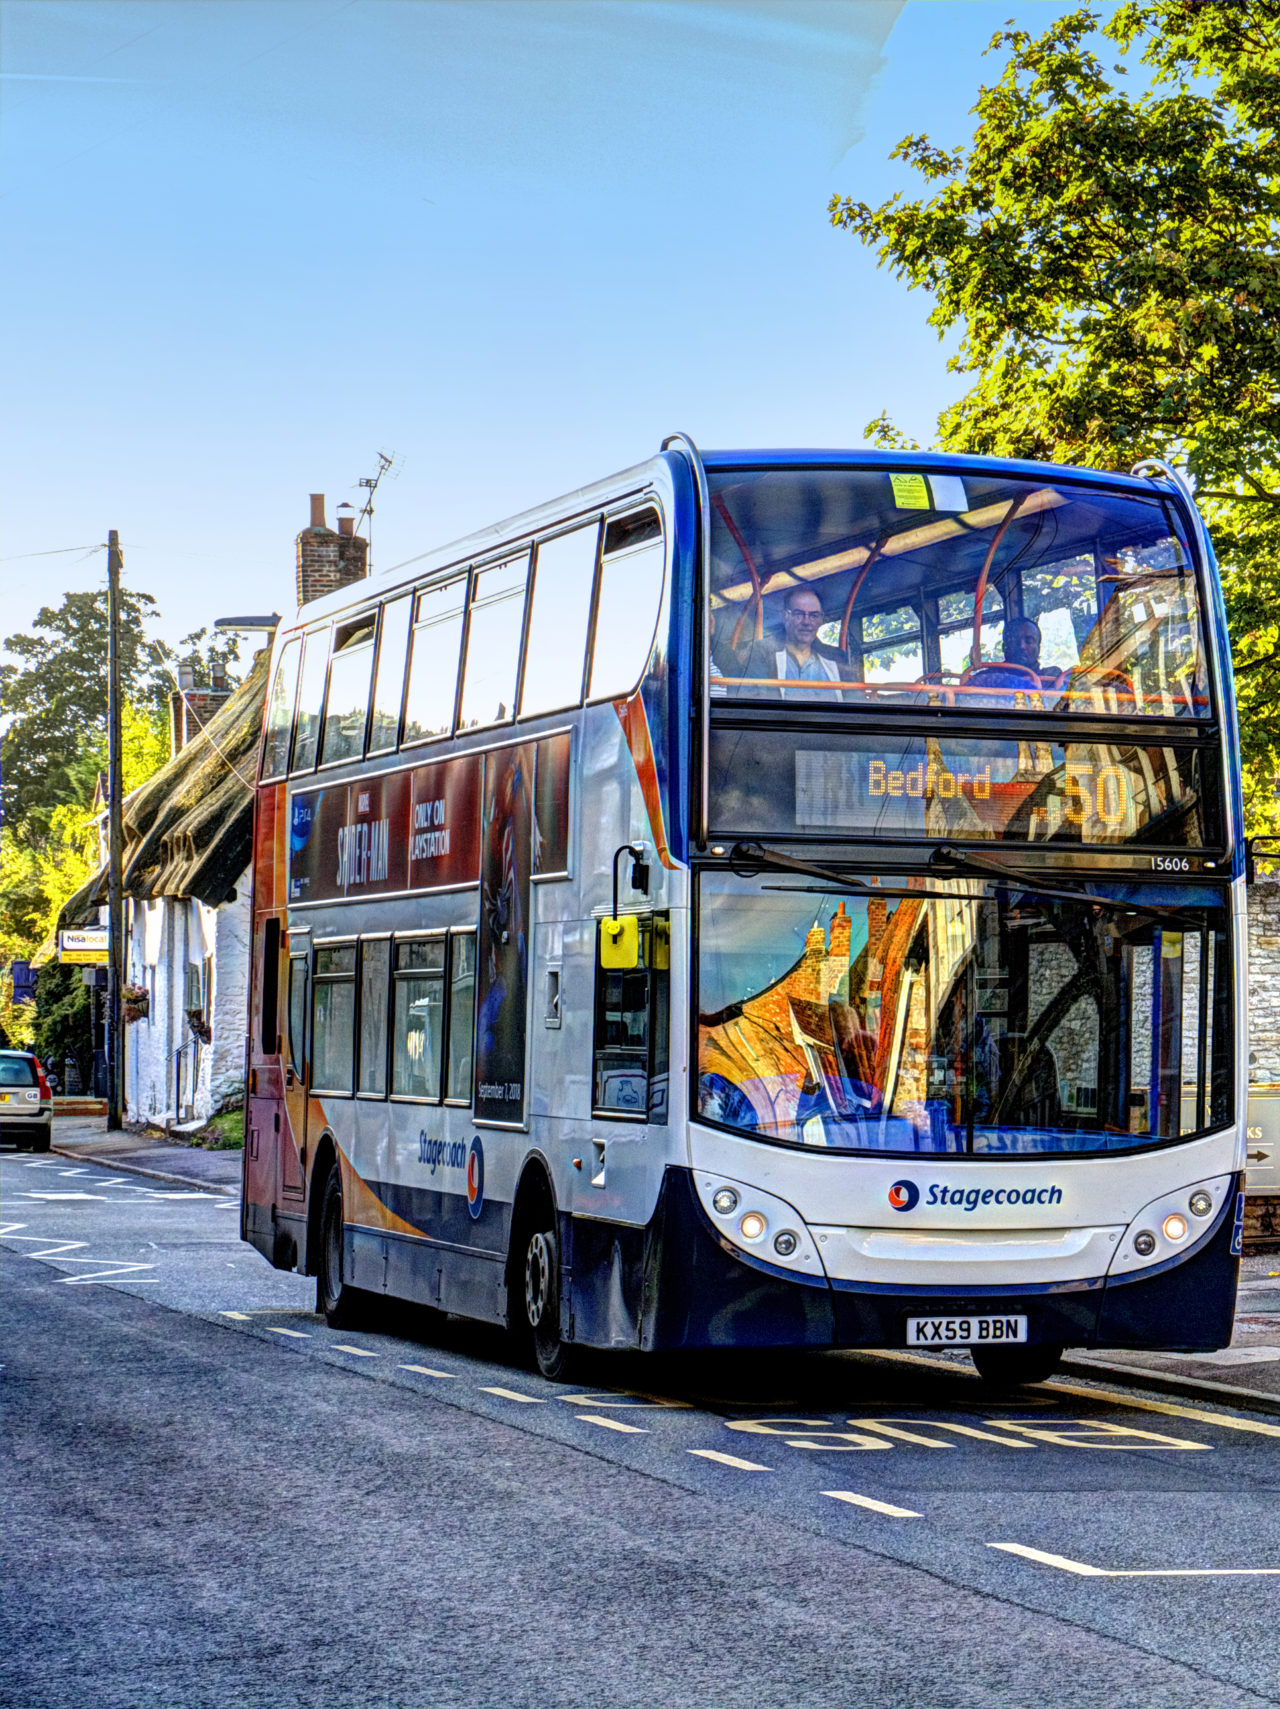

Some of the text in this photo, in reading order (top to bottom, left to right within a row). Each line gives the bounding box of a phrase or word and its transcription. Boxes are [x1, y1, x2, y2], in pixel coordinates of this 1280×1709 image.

[868, 760, 1127, 825] Bedford 50
[414, 799, 446, 829] ONLY ON
[410, 829, 451, 861] LAYSTATION
[1150, 857, 1190, 871] 15606
[26, 1091, 38, 1099] GB
[418, 1129, 467, 1176] Stagecoach
[925, 1183, 1063, 1212] Stagecoach
[915, 1318, 1019, 1341] KX59 BBN
[724, 1418, 1215, 1451] BUS
